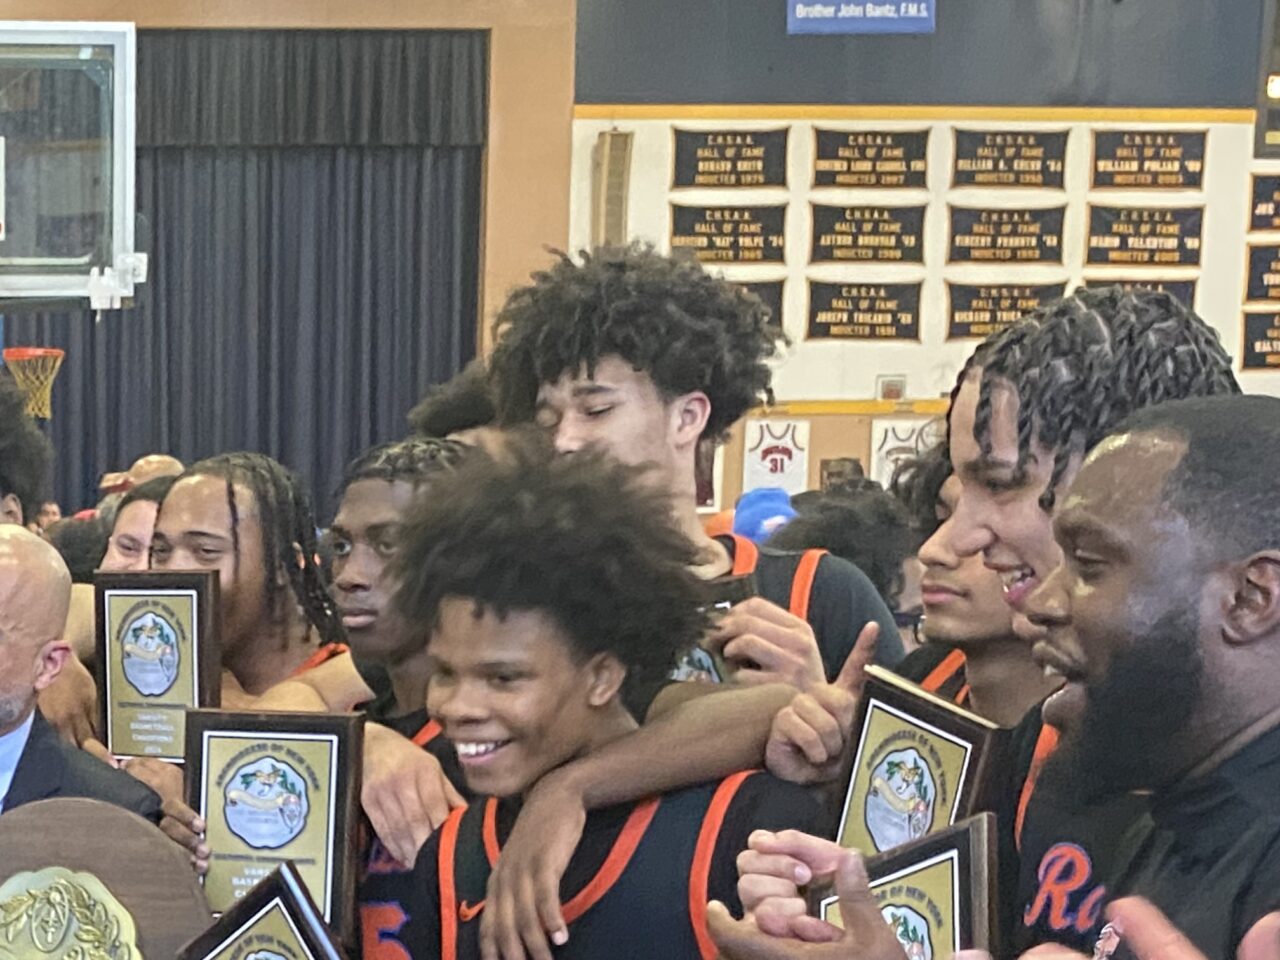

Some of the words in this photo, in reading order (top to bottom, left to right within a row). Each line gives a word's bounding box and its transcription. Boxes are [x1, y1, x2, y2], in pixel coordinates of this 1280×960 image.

[796, 4, 836, 18] Brother
[838, 4, 864, 18] John
[769, 458, 784, 473] 31
